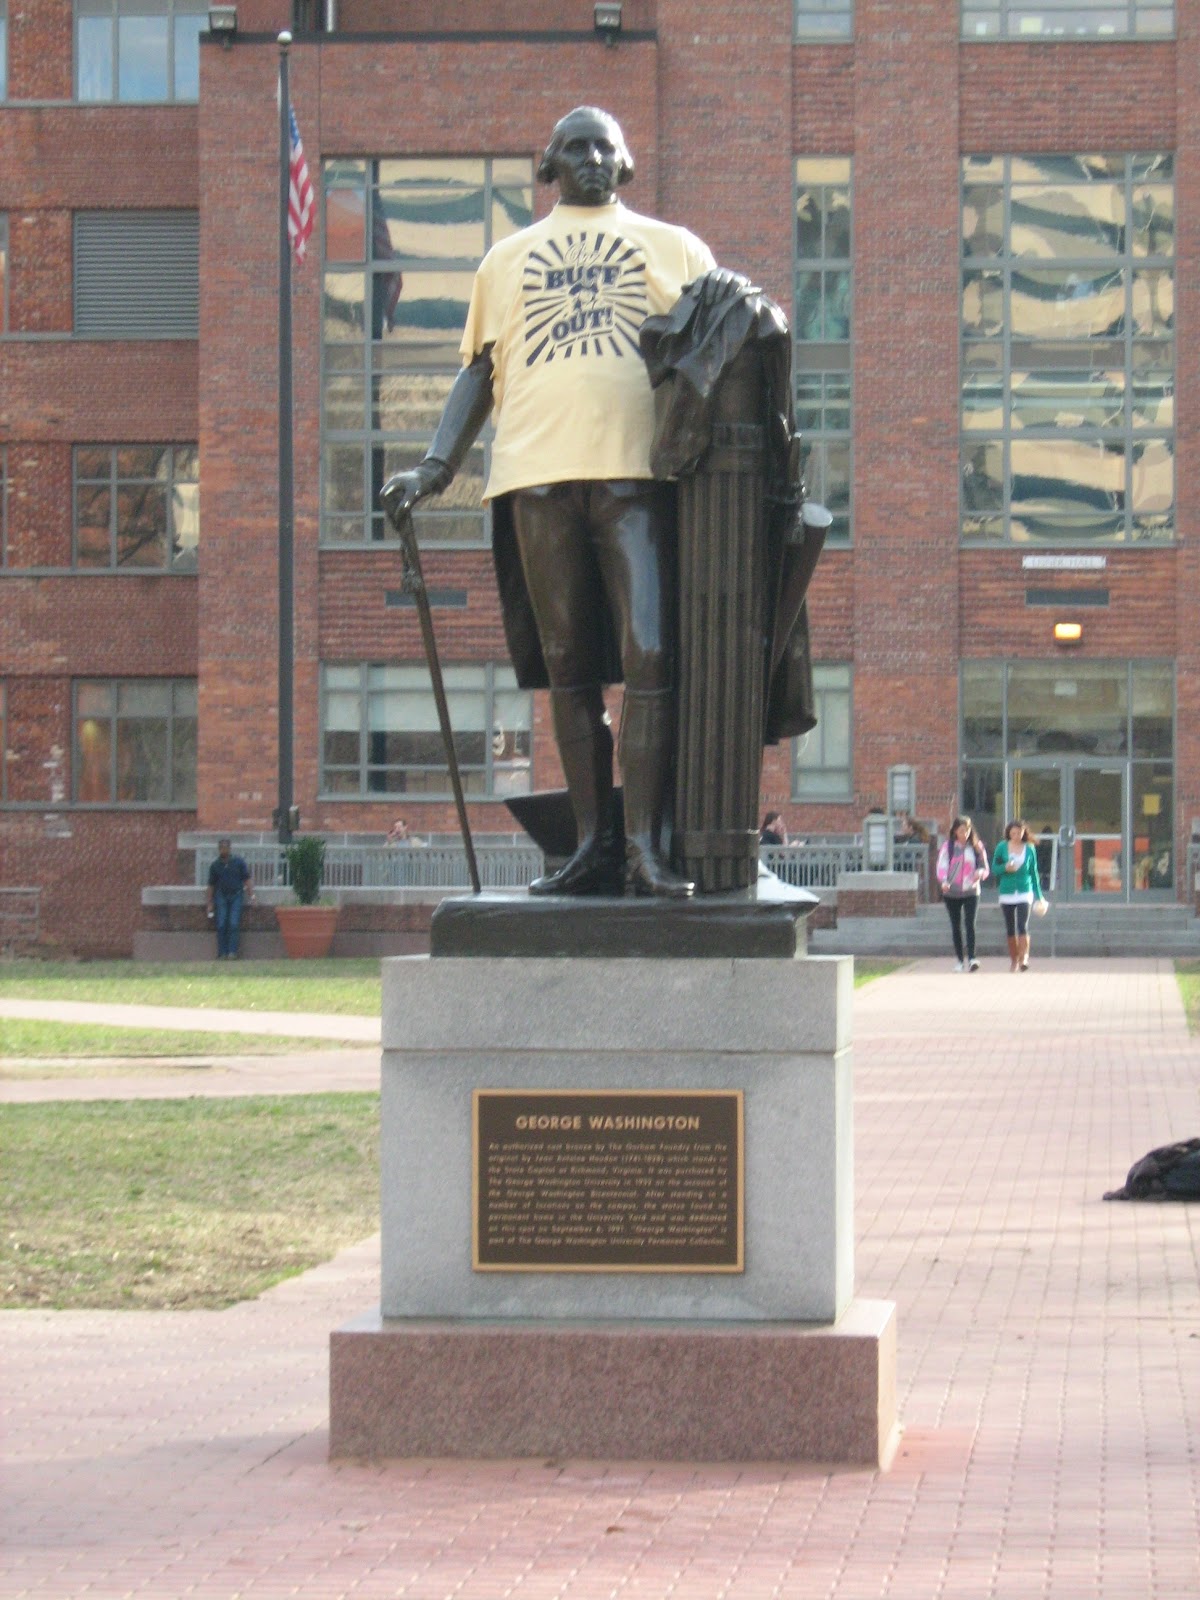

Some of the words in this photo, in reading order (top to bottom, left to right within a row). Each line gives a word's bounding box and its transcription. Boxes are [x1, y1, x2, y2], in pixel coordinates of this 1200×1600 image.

[551, 306, 614, 341] OUT!
[515, 1115, 582, 1130] GEORGE
[589, 1115, 700, 1130] WASHINGTON
